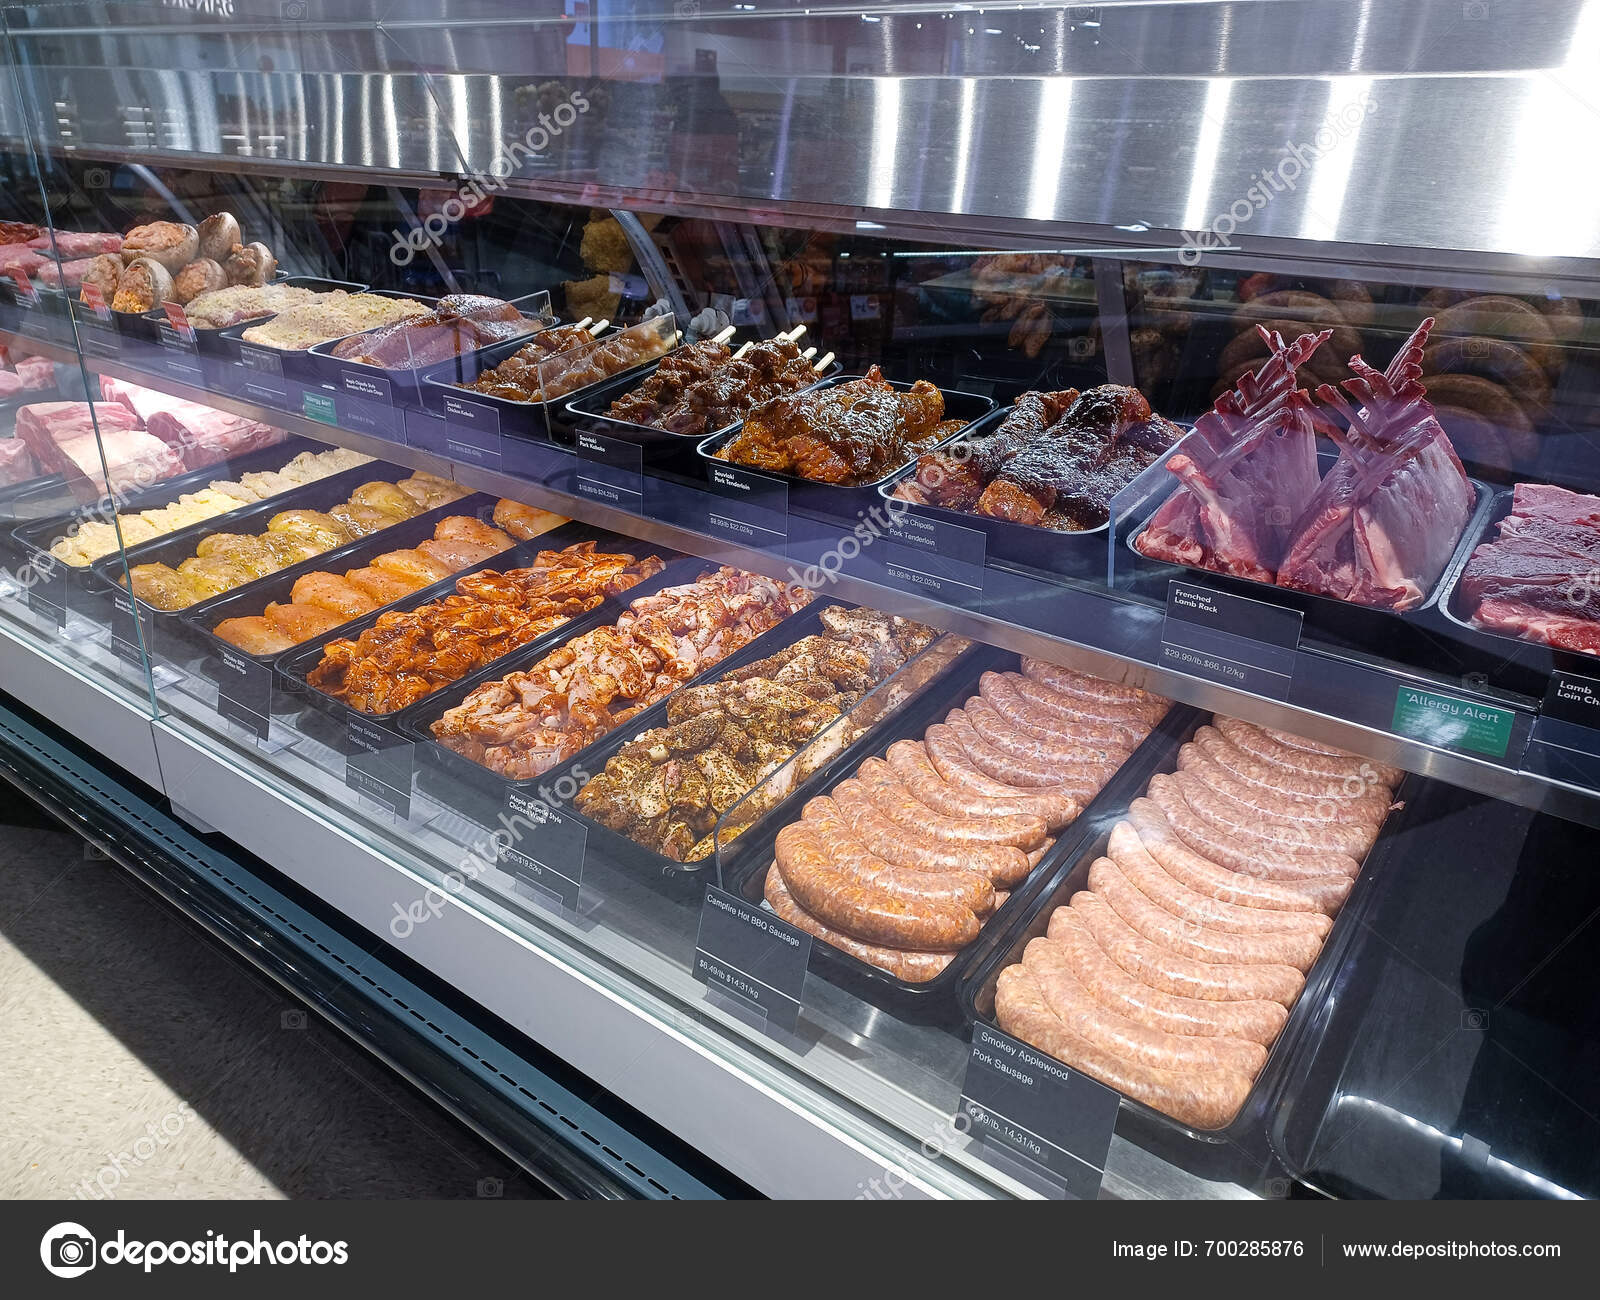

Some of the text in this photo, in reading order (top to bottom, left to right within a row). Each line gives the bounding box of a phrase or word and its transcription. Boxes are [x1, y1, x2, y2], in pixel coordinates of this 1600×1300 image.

[579, 440, 590, 448] Pork
[714, 469, 735, 480] Souvlaki
[714, 476, 726, 484] Pork
[910, 519, 935, 531] Chipotle
[889, 527, 936, 546] Pork Tenderloin
[1174, 596, 1218, 614] Lamb Rack
[1175, 589, 1212, 604] Frenched
[1560, 680, 1592, 695] Lamb
[1557, 689, 1600, 706] Loin Ch
[1463, 706, 1500, 724] Alert
[508, 801, 530, 816] Chicken
[509, 794, 526, 807] Maple
[548, 812, 562, 824] Style
[707, 893, 800, 948] Campfire Hot BBQ Sausage
[726, 974, 759, 999] $14.31/kg
[981, 1031, 1069, 1081] Smokey Applewood
[973, 1048, 1034, 1086] Pork Sausage
